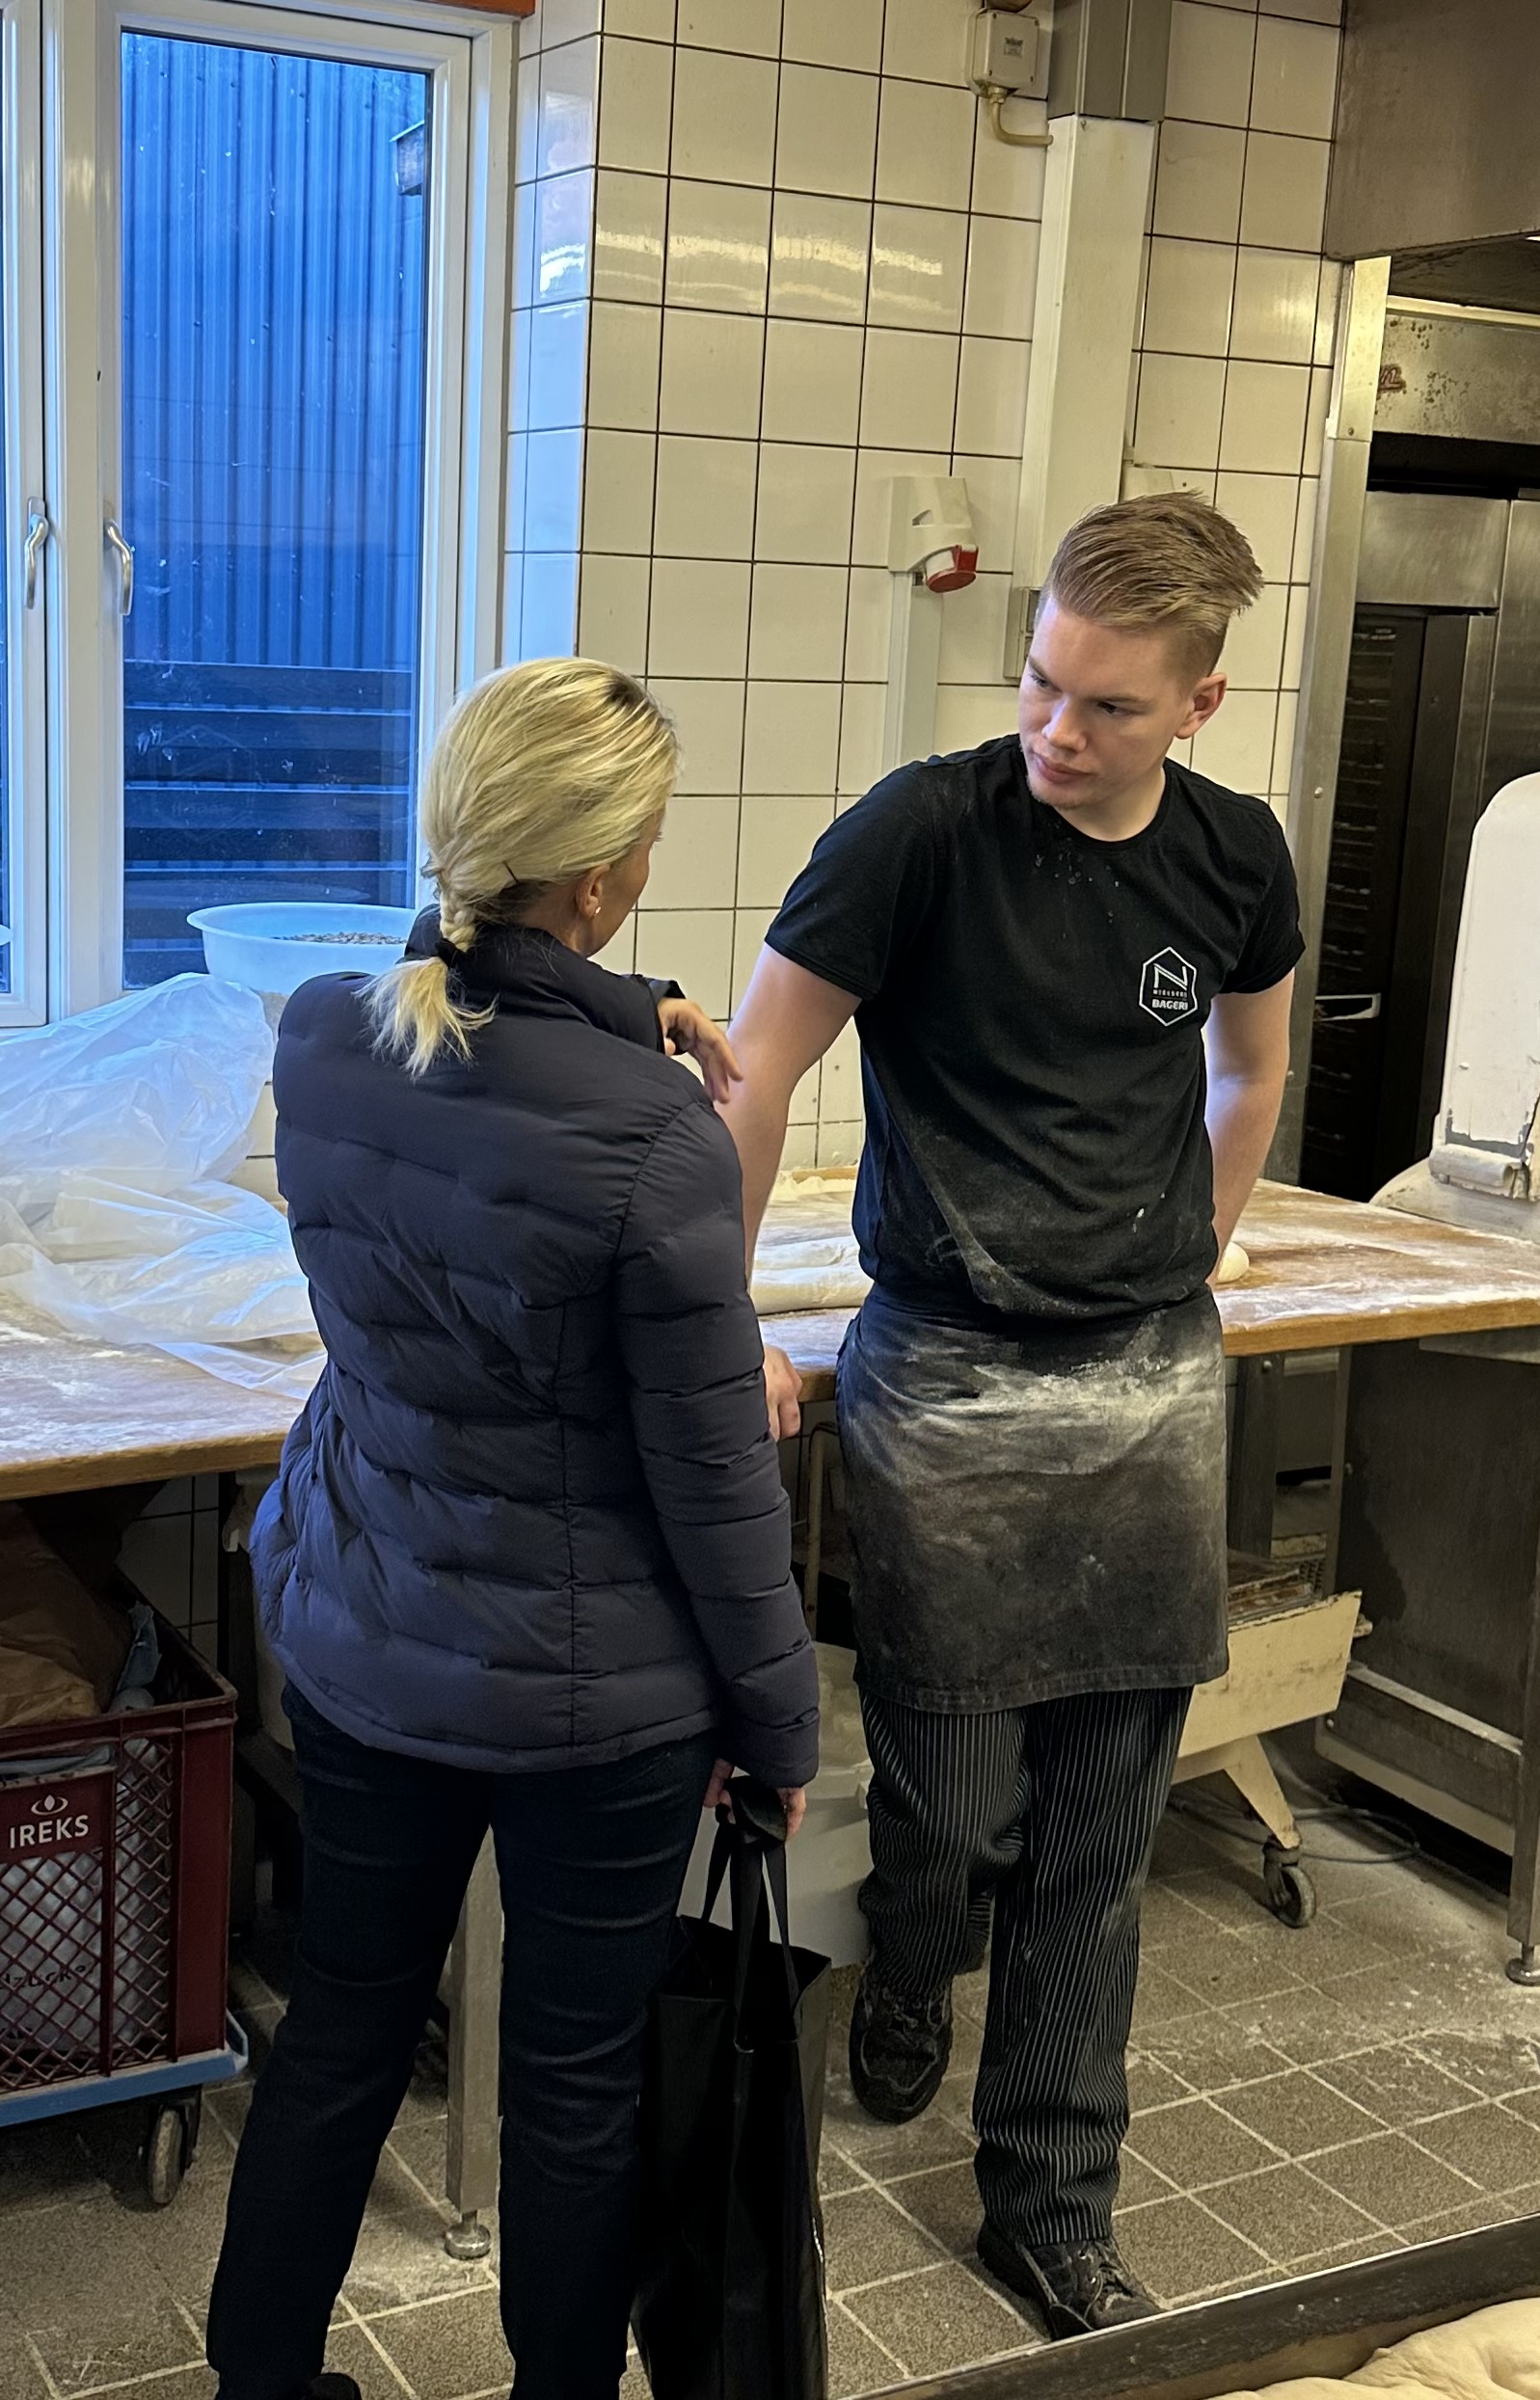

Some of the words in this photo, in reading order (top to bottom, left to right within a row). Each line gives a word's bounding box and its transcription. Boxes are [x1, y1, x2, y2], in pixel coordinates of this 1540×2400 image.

[1153, 963, 1187, 990] N
[1151, 999, 1188, 1011] BAGERI
[9, 1815, 89, 1848] IREKS
